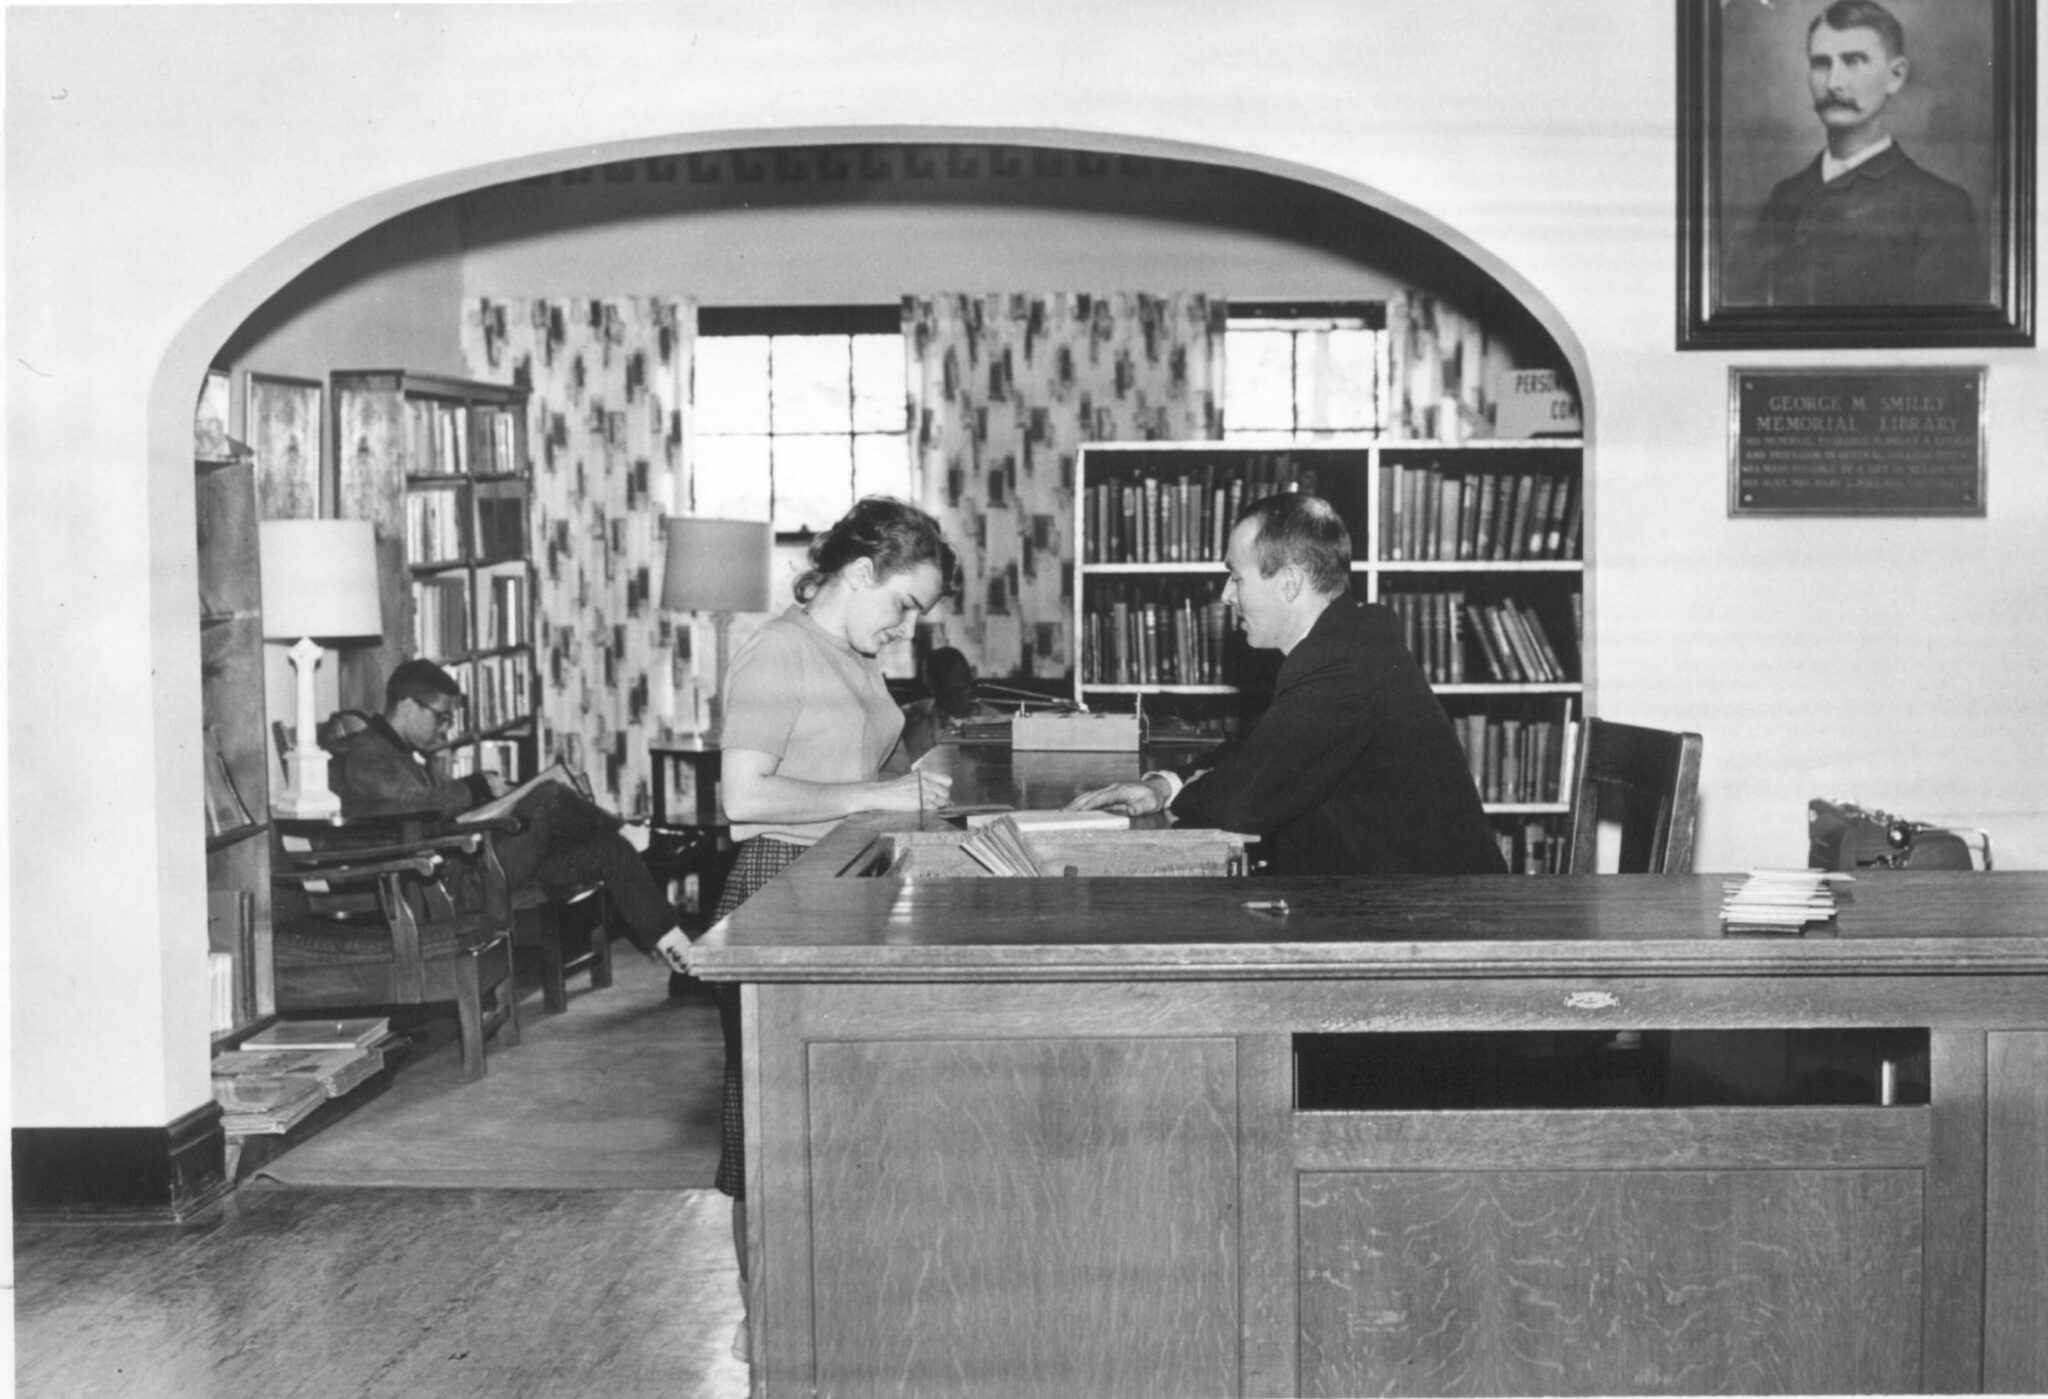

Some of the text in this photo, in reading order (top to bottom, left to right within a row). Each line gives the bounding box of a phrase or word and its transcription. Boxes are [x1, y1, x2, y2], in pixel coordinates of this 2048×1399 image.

[1769, 395, 1842, 412] GEORGE
[1880, 395, 1945, 412] SMILEY
[1757, 415, 1958, 432] MEMORIAL LIBRARY
